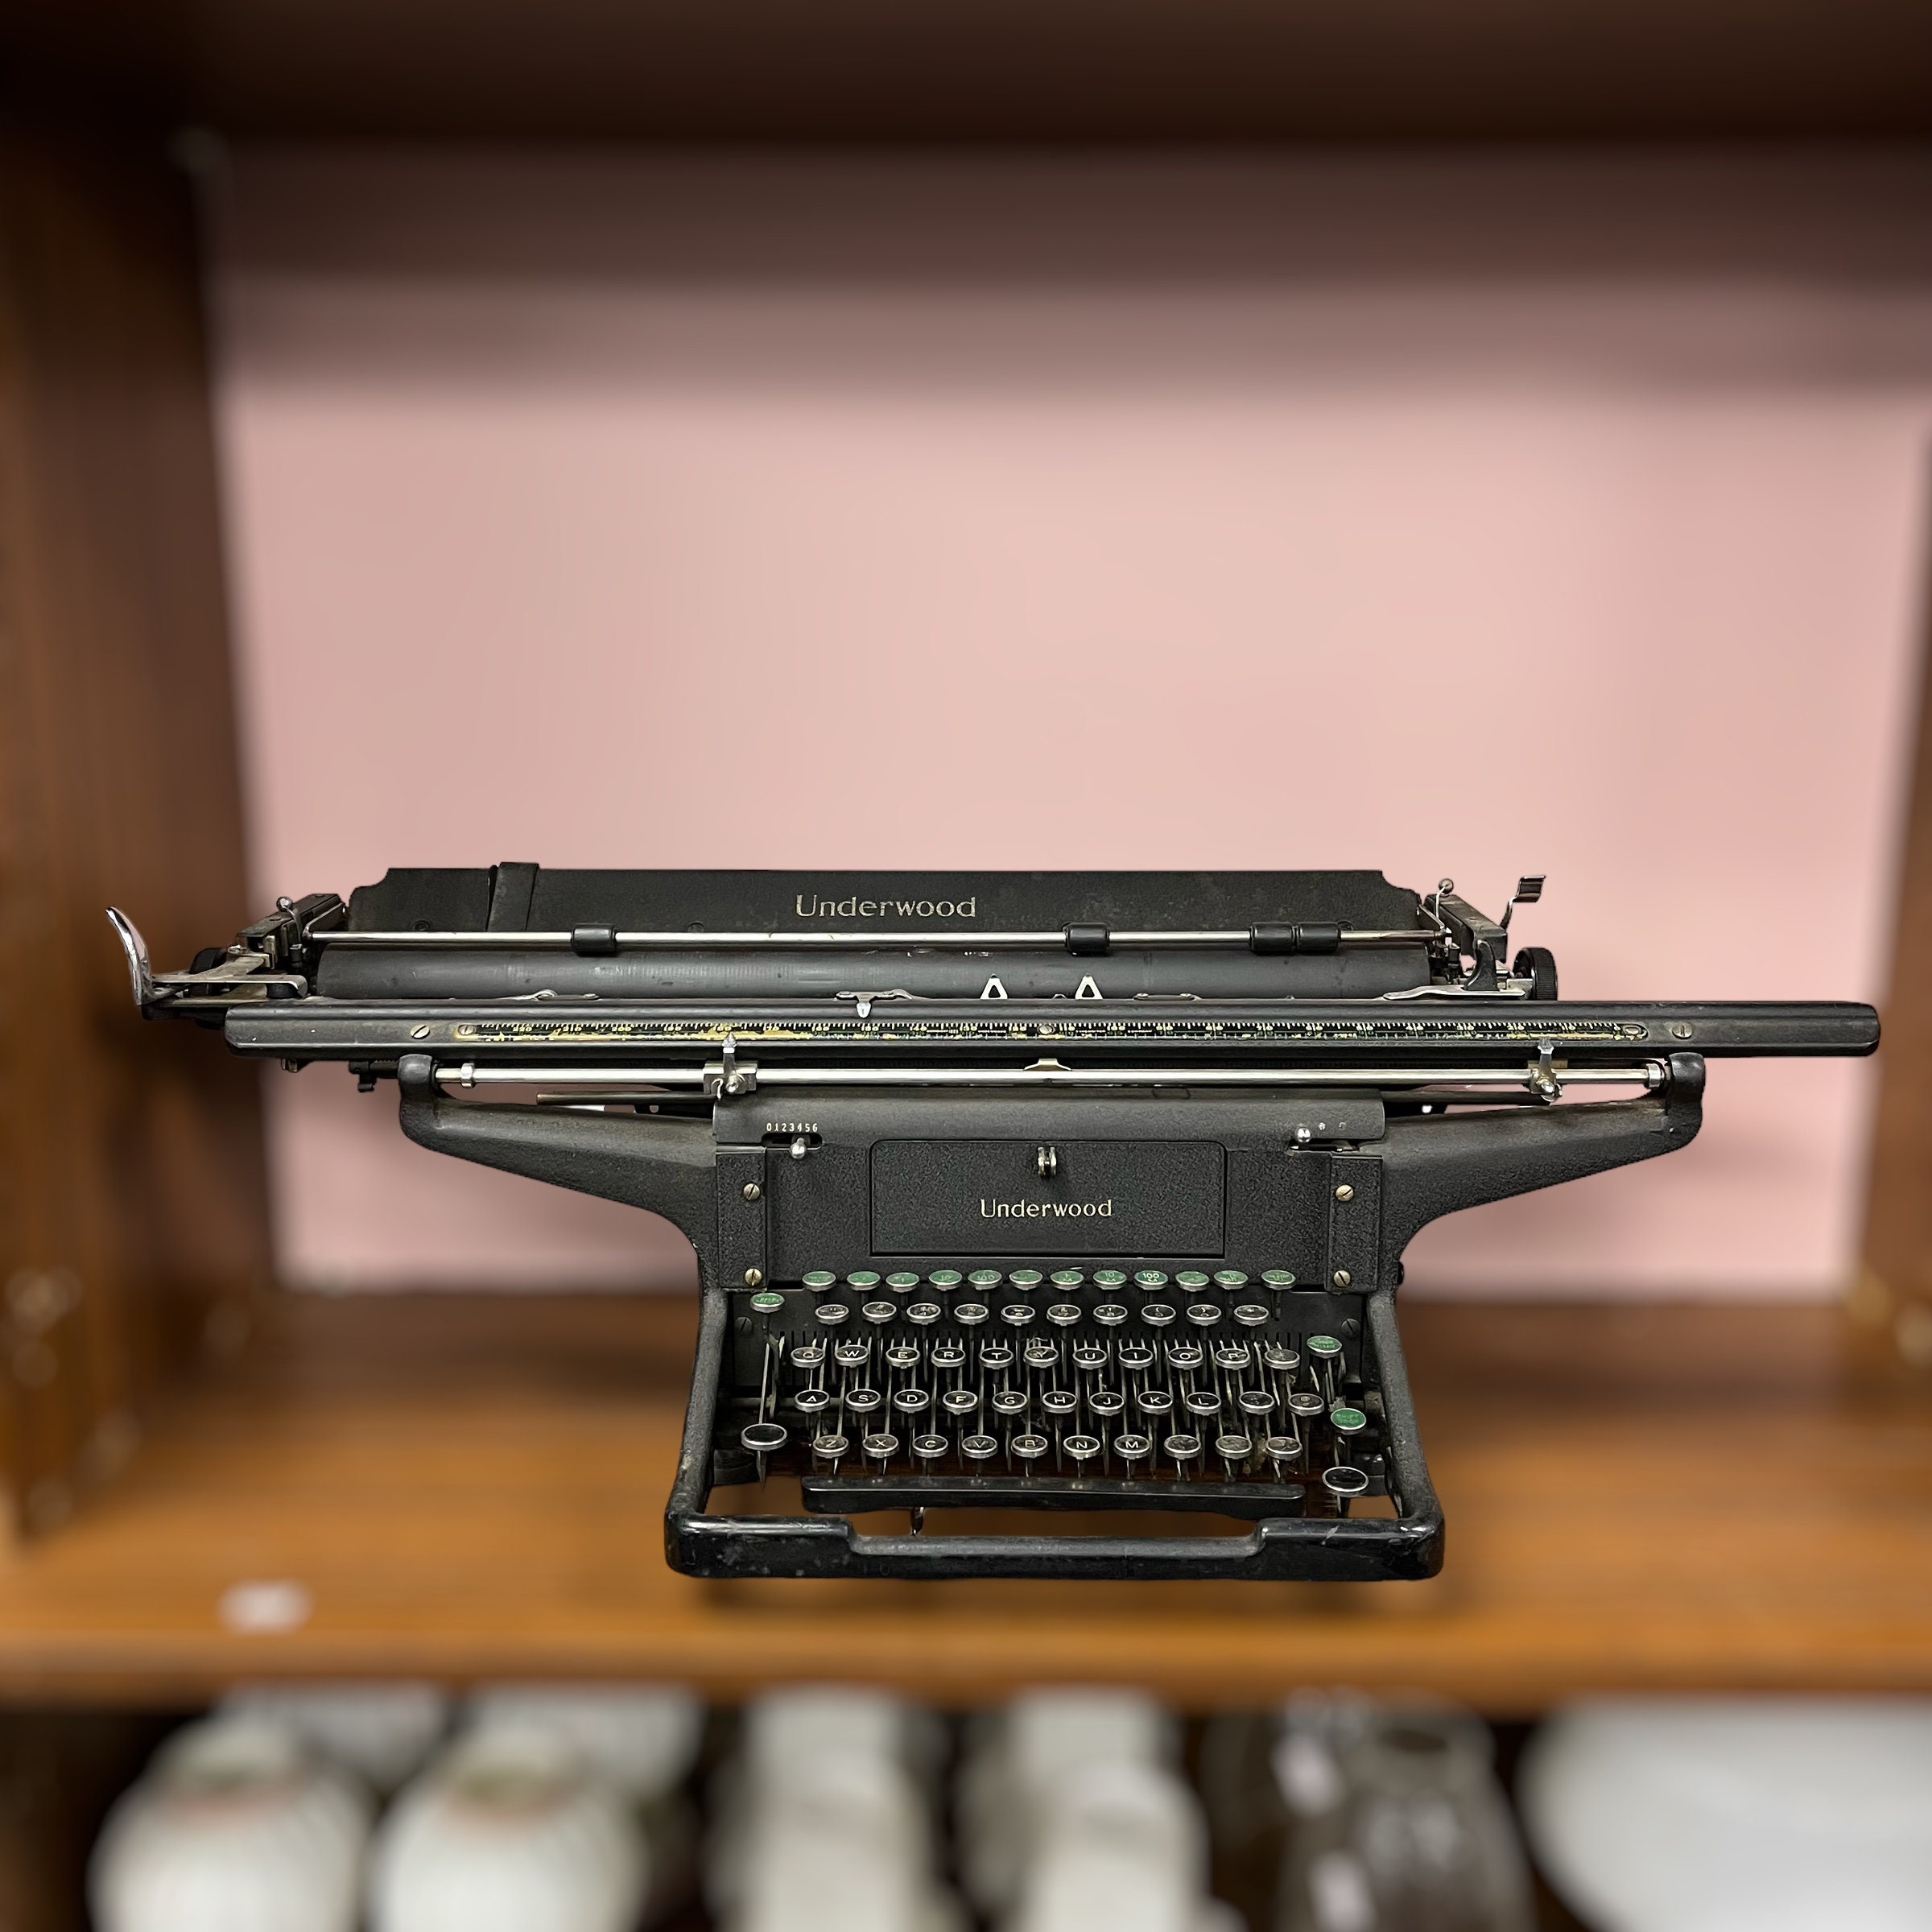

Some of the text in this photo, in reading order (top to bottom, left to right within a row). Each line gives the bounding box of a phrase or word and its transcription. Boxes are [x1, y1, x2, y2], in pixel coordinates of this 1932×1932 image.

[796, 894, 976, 917] Underwood
[980, 1199, 1113, 1218] Underwood
[1036, 1350, 1047, 1358] Y
[1133, 1352, 1138, 1360] I
[858, 1394, 869, 1402] S
[906, 1394, 918, 1402] D
[1005, 1396, 1015, 1404] G
[1054, 1396, 1066, 1404] H
[1103, 1397, 1111, 1405] J
[826, 1440, 836, 1448] Z
[925, 1440, 936, 1448] C
[974, 1440, 985, 1448] V
[1025, 1439, 1035, 1447] B
[1076, 1441, 1088, 1449] N
